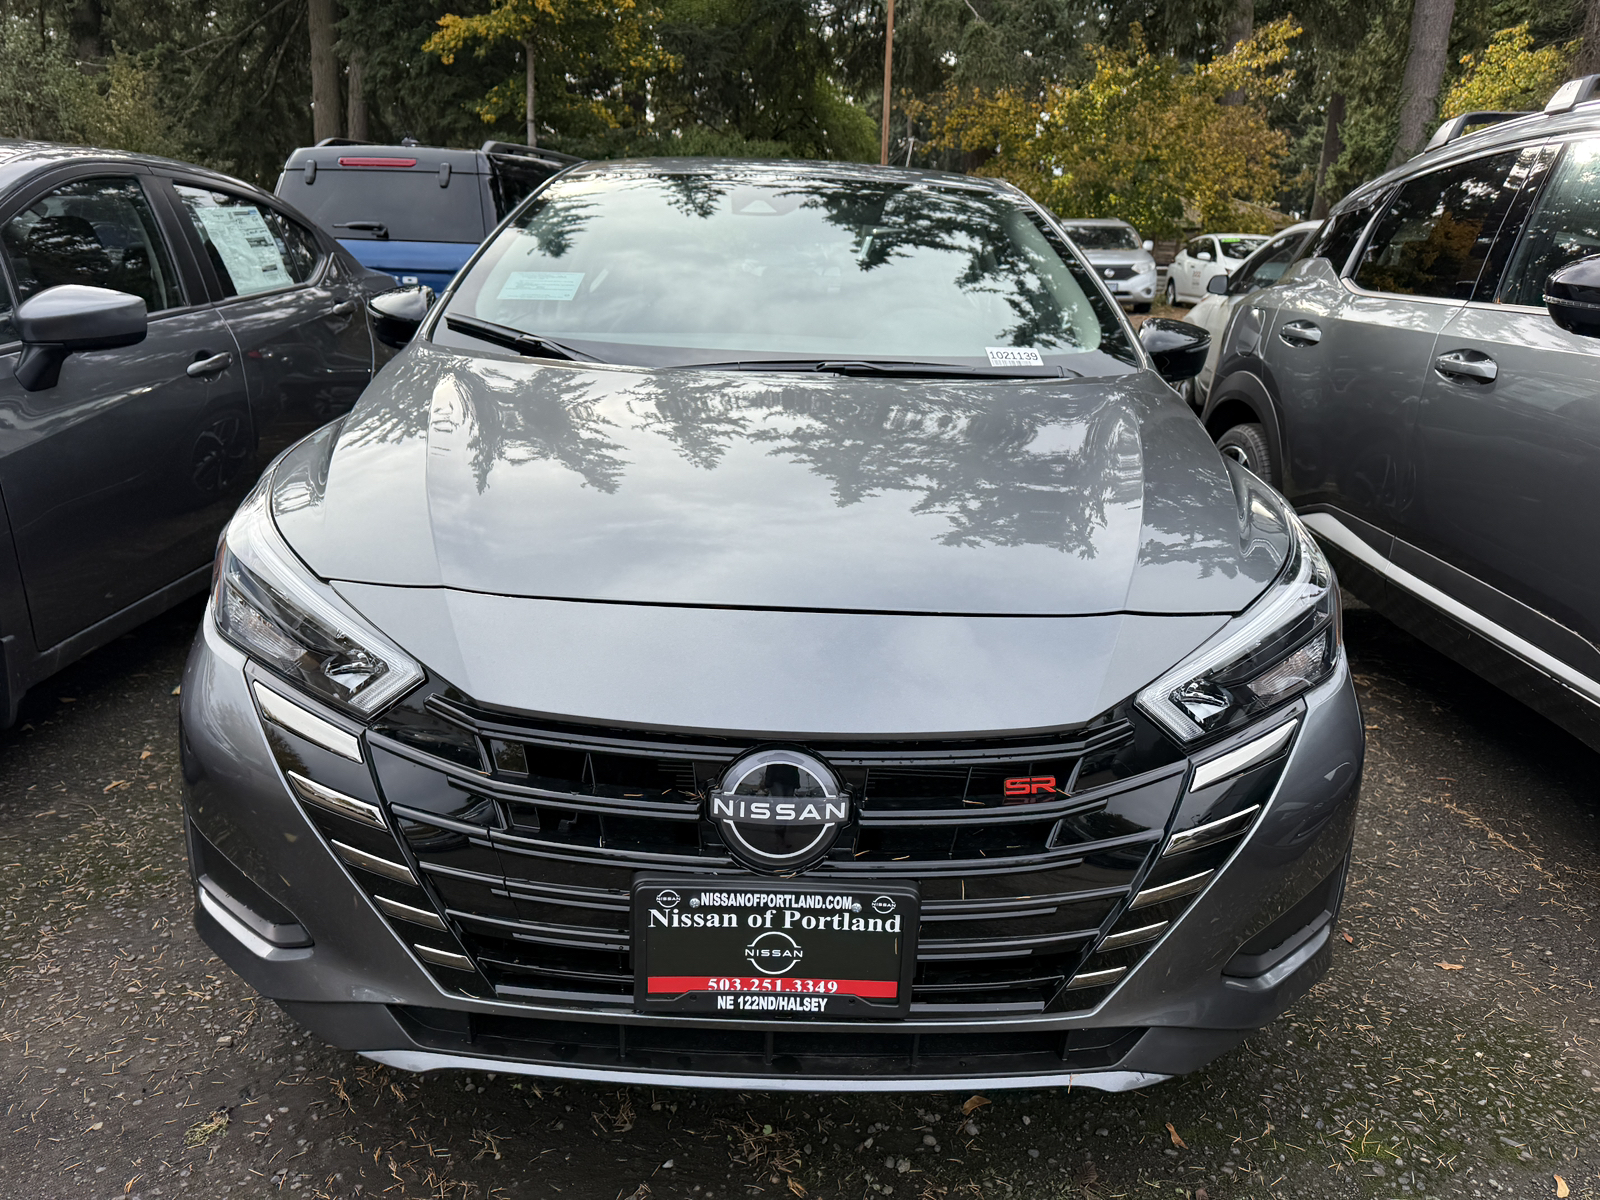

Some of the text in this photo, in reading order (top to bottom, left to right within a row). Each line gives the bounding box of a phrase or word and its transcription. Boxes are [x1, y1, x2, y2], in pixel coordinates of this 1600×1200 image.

[989, 351, 1039, 361] 1021139
[1004, 776, 1057, 795] SR
[713, 797, 846, 821] NISSAN
[700, 892, 853, 910] NISSANOFPORTLAND.COM
[648, 908, 901, 933] Nissan of Portland
[745, 948, 803, 958] NISSAN
[707, 978, 838, 994] 503.251.3349
[717, 995, 828, 1012] NE 122ND/HALSEY
